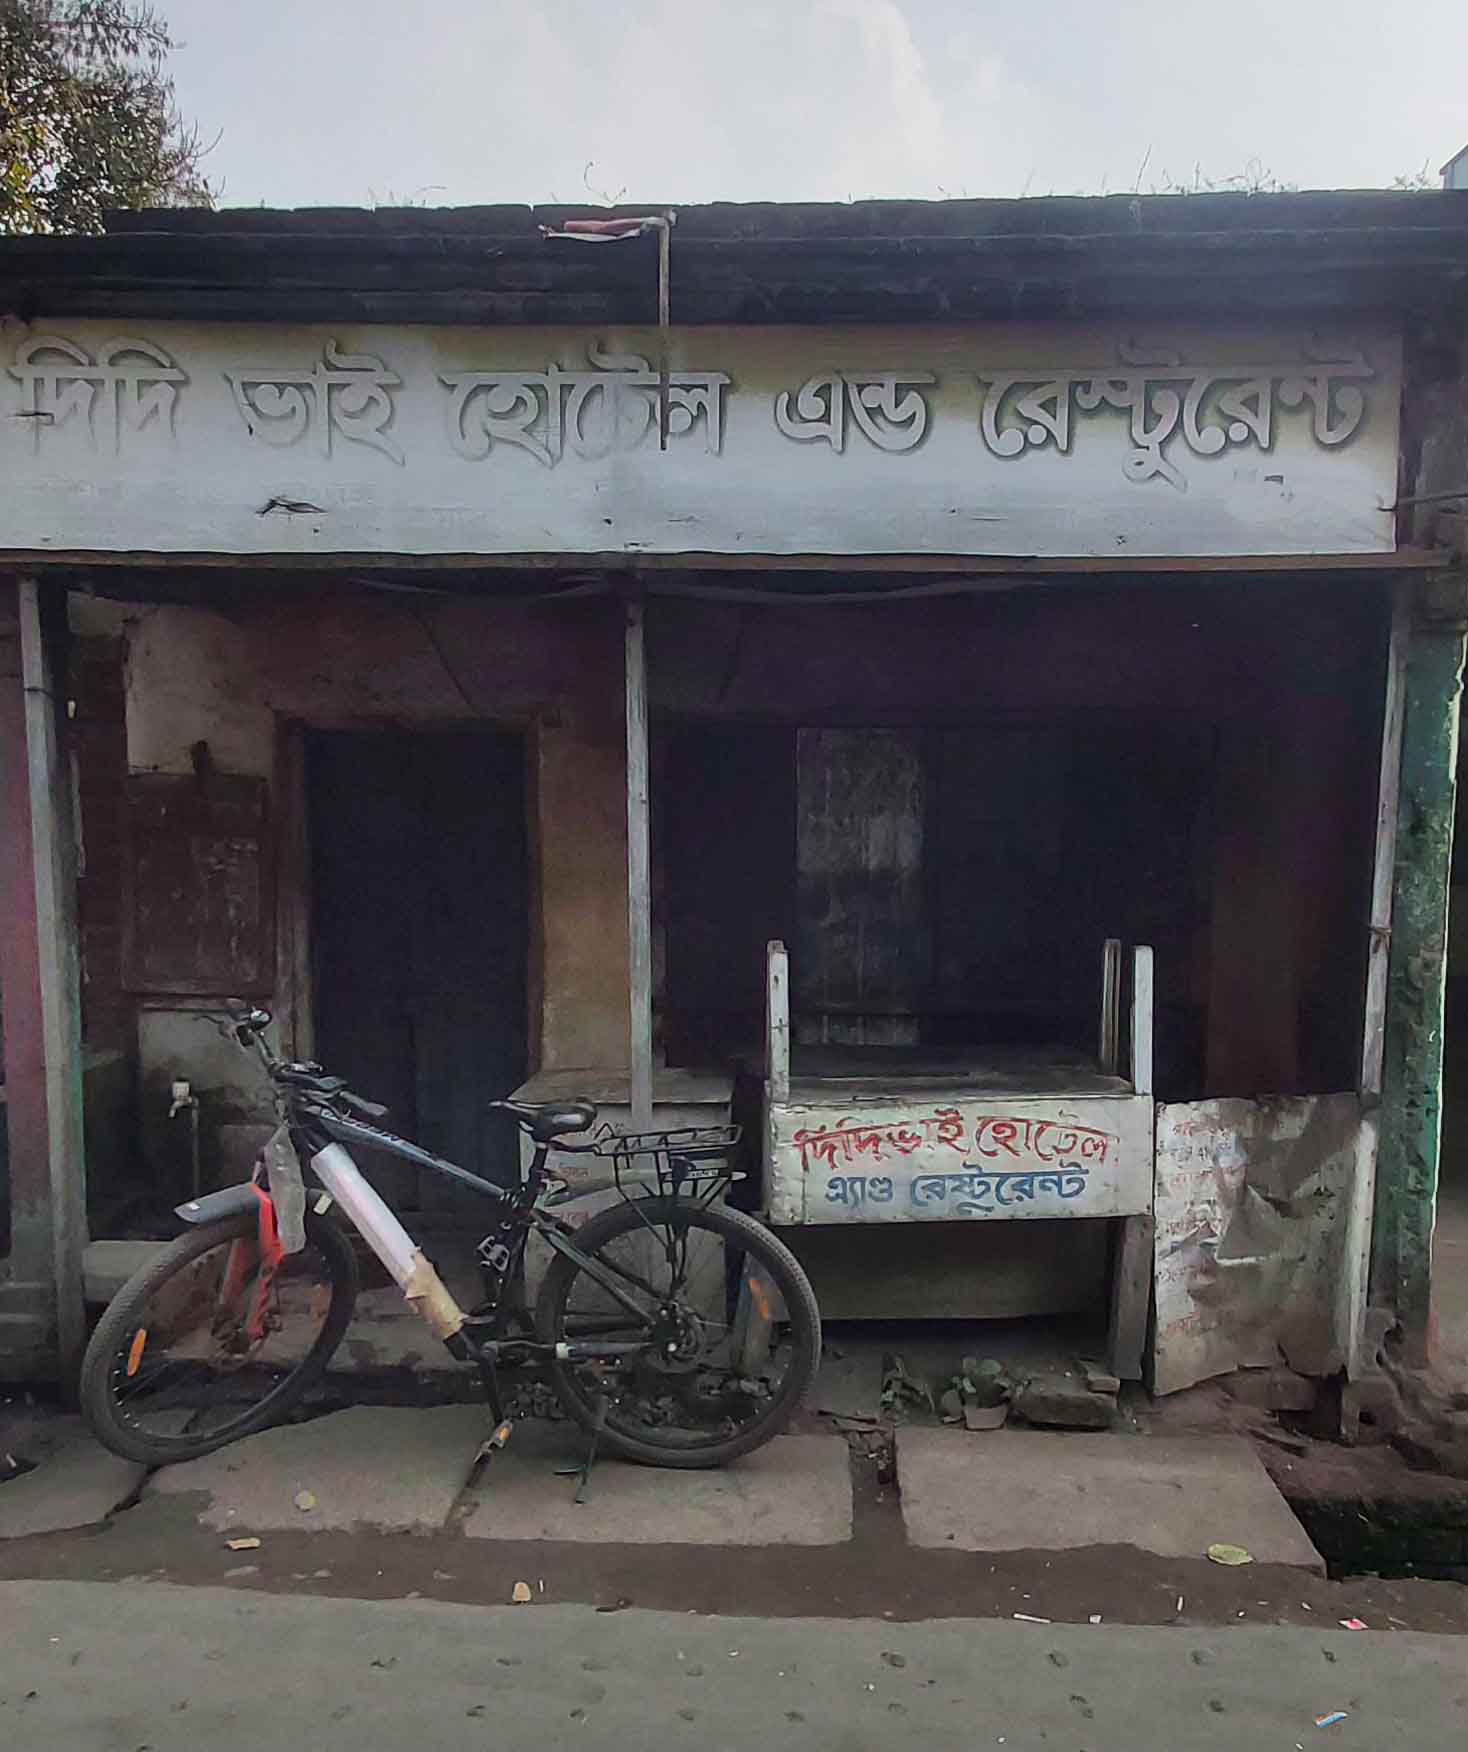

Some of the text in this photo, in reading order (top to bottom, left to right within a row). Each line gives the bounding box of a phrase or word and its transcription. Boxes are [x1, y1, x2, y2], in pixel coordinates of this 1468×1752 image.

[6, 336, 189, 456] দিদি
[223, 337, 405, 466] ভাই
[438, 339, 731, 469] হোটেল
